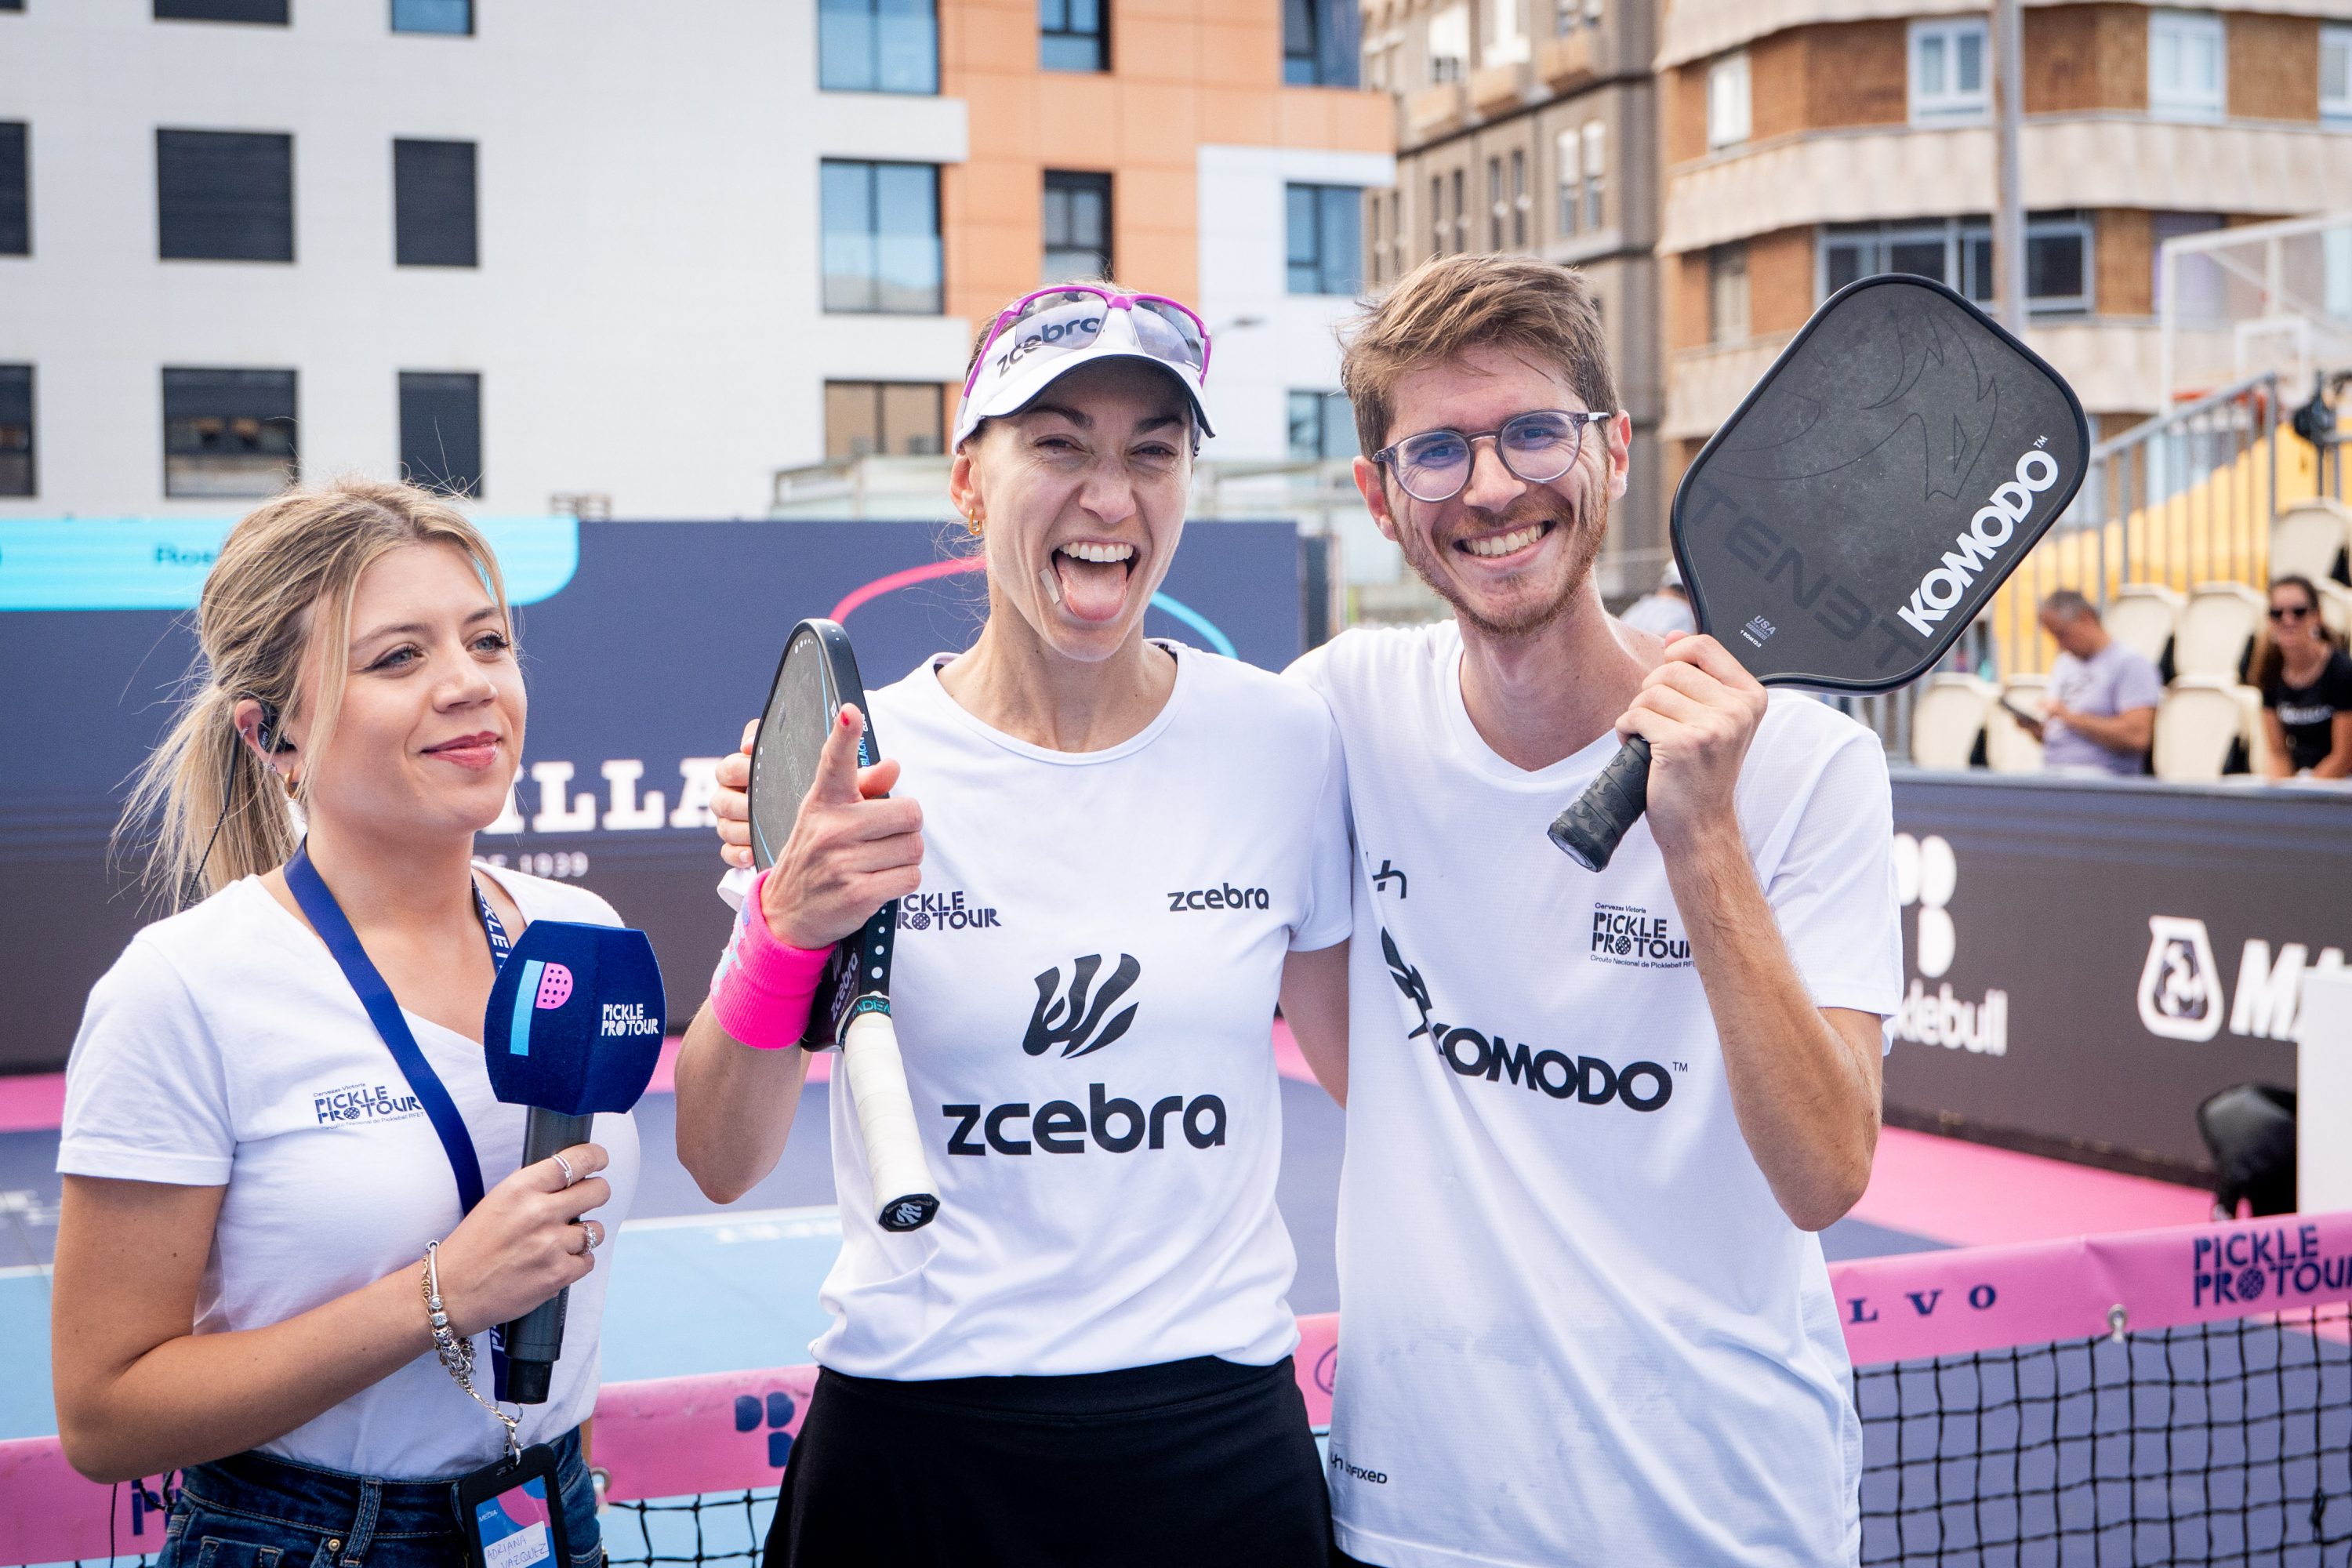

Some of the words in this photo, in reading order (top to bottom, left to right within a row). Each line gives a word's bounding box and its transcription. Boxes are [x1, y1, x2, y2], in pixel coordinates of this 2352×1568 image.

[996, 317, 1105, 379] zcebra
[1897, 450, 2059, 637] KOMODO
[1755, 615, 1777, 635] USA
[897, 891, 964, 913] ICKLE
[1167, 882, 1269, 912] zcebra
[1595, 902, 1624, 911] Cervezas
[1625, 906, 1646, 914] Victoria
[896, 908, 1002, 931] ROTOUR
[1592, 912, 1668, 939] PICKLE
[1590, 955, 1613, 964] Circuito
[1613, 958, 1640, 967] Nacional
[1650, 960, 1682, 969] Pickleball
[831, 952, 858, 1022] zcebra
[602, 1004, 644, 1020] PICKLE
[313, 1088, 341, 1098] Cervezas
[341, 1082, 366, 1091] Victoria
[314, 1085, 389, 1113] PICKLE
[380, 1114, 408, 1123] Pickleball
[942, 1083, 1227, 1156] zcebra
[2193, 1224, 2319, 1270] PICKLE
[1847, 1283, 1998, 1325] LVO
[478, 1509, 499, 1522] MEDIA
[487, 1534, 528, 1560] ADRIANA
